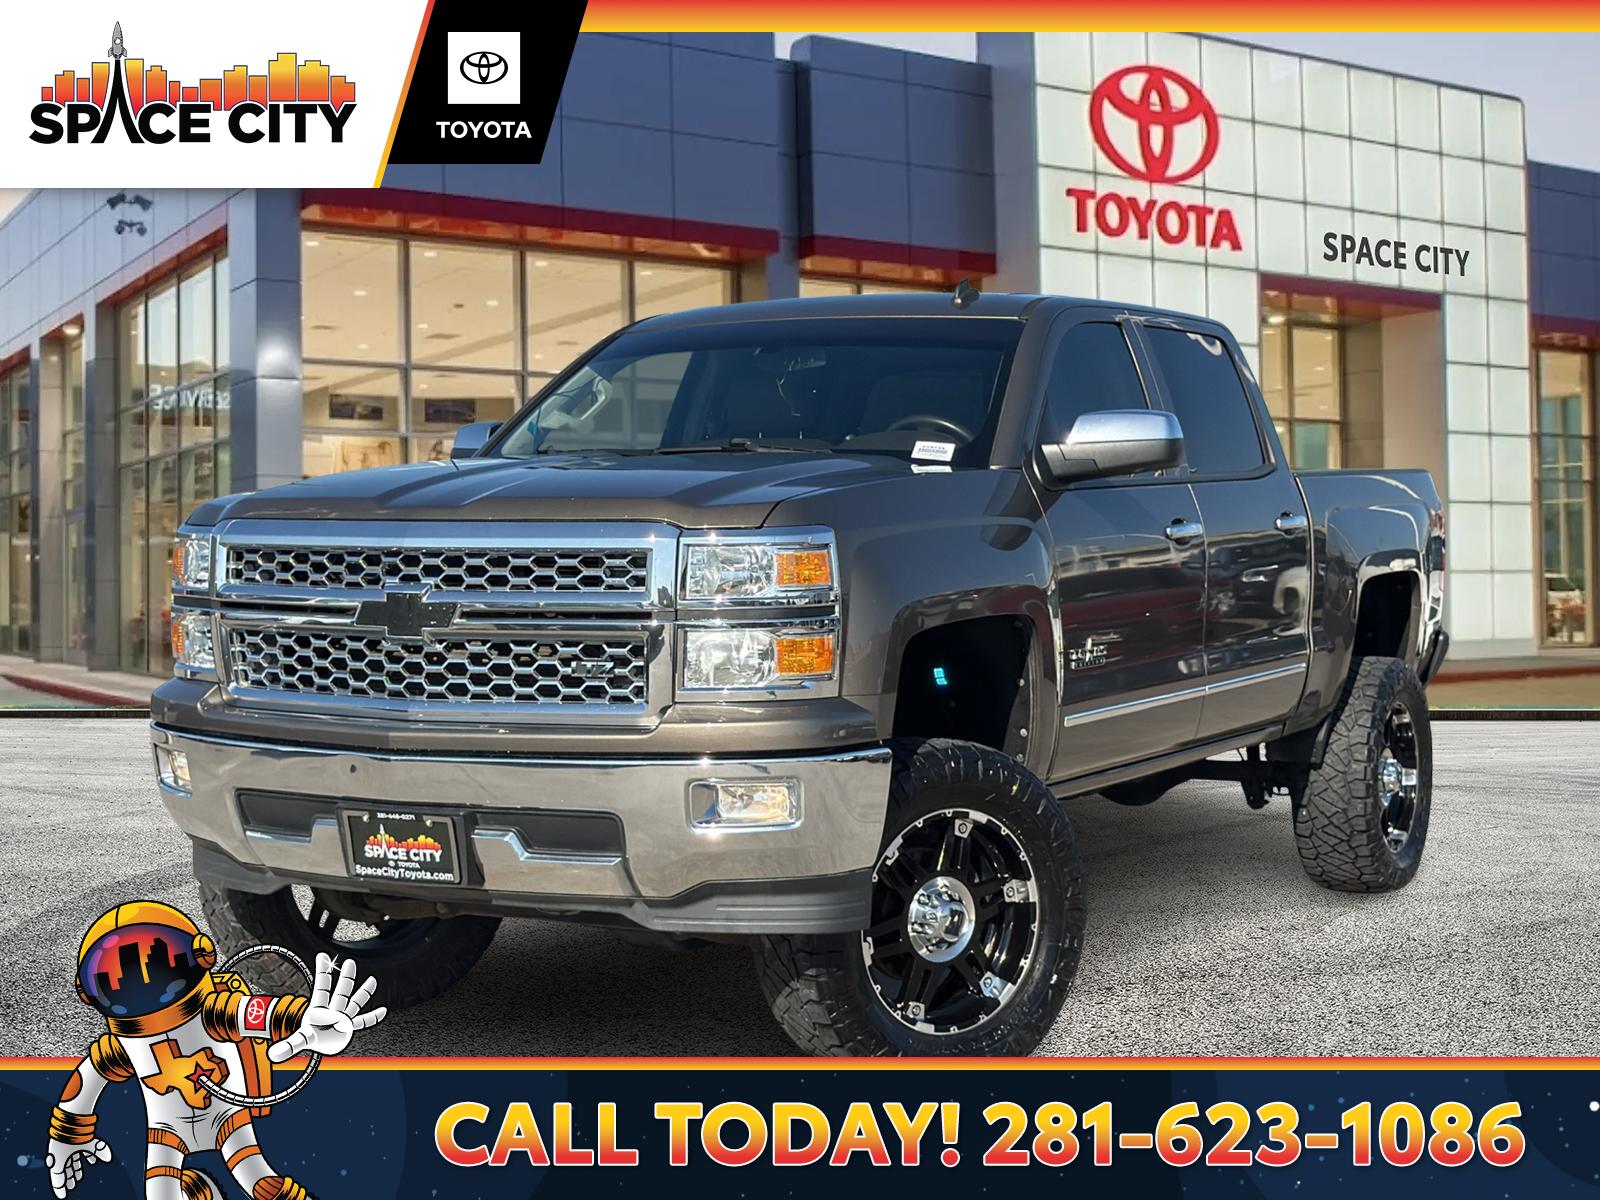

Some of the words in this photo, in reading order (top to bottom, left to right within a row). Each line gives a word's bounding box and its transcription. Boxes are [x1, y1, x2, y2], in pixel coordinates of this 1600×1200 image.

[1065, 187, 1243, 251] TOYOTA
[1323, 231, 1407, 270] SPACE
[1414, 244, 1470, 276] CITY
[571, 661, 614, 677] LTZ
[364, 839, 407, 860] SPACE
[409, 848, 442, 862] CITY
[355, 864, 454, 881] SpaceCityToyota.com
[397, 861, 421, 869] TOYOTA
